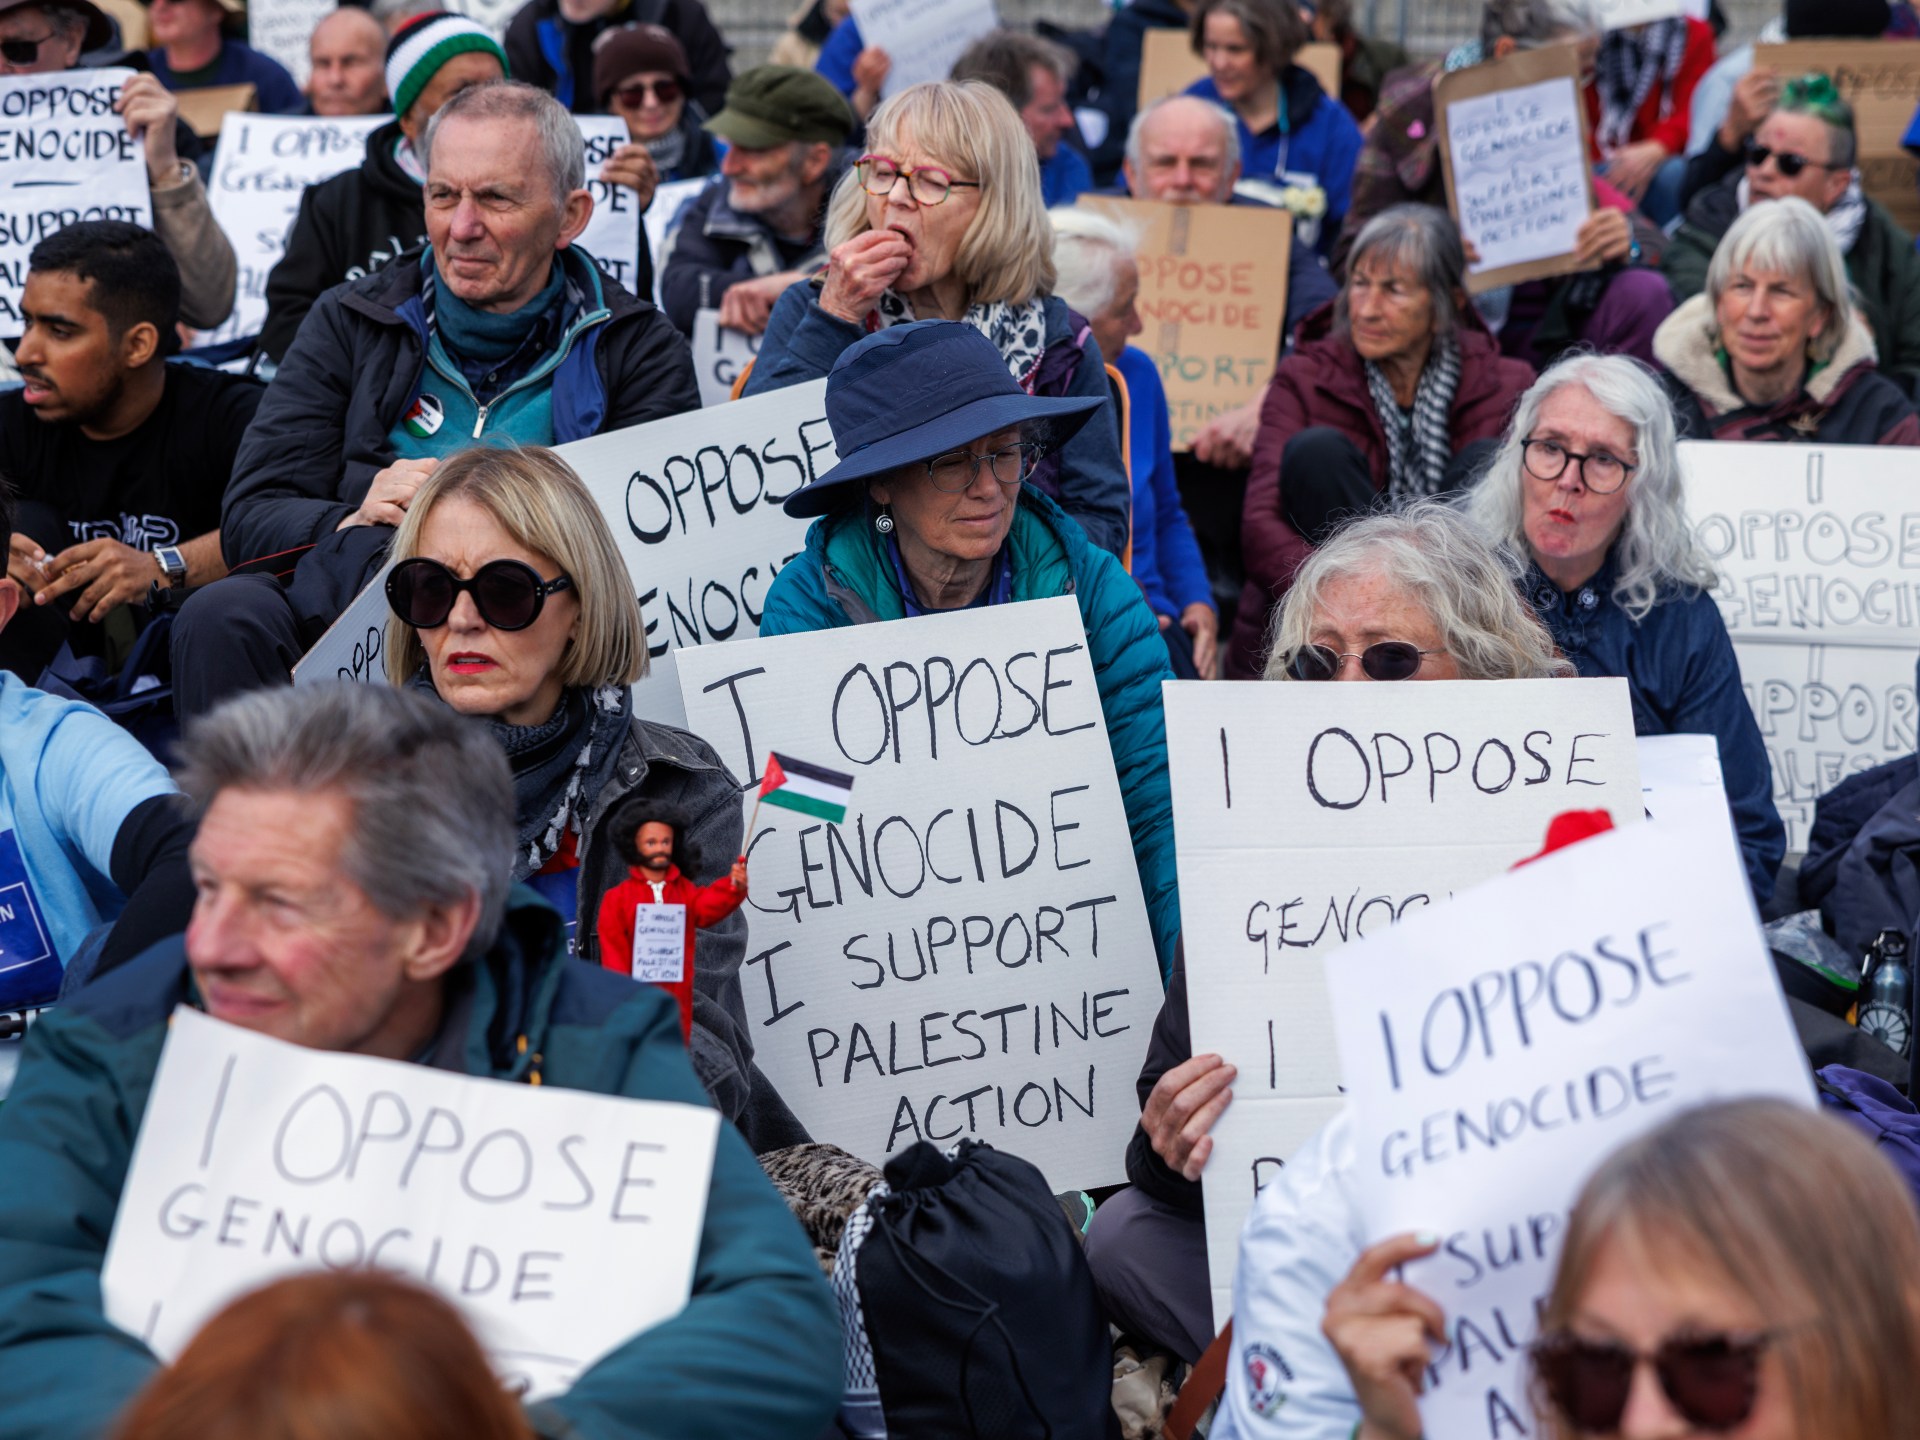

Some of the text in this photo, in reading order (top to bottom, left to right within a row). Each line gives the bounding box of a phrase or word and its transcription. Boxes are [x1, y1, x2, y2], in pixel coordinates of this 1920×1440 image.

[1806, 451, 1824, 504] I
[1713, 572, 1920, 630] GENOCI
[832, 643, 1096, 765] OPPOSE
[1220, 727, 1610, 810] I OPPOSE
[745, 784, 1091, 923] GENOCIDE
[745, 895, 1117, 1027] I SUPPORT
[1379, 919, 1695, 1091] I OPPOSE
[807, 988, 1131, 1088] PALESTINE
[199, 1054, 667, 1223] I OPPOSE
[885, 1064, 1095, 1153] ACTION
[1380, 1054, 1677, 1179] GENOCIDE
[157, 1183, 564, 1303] GENOCIDE
